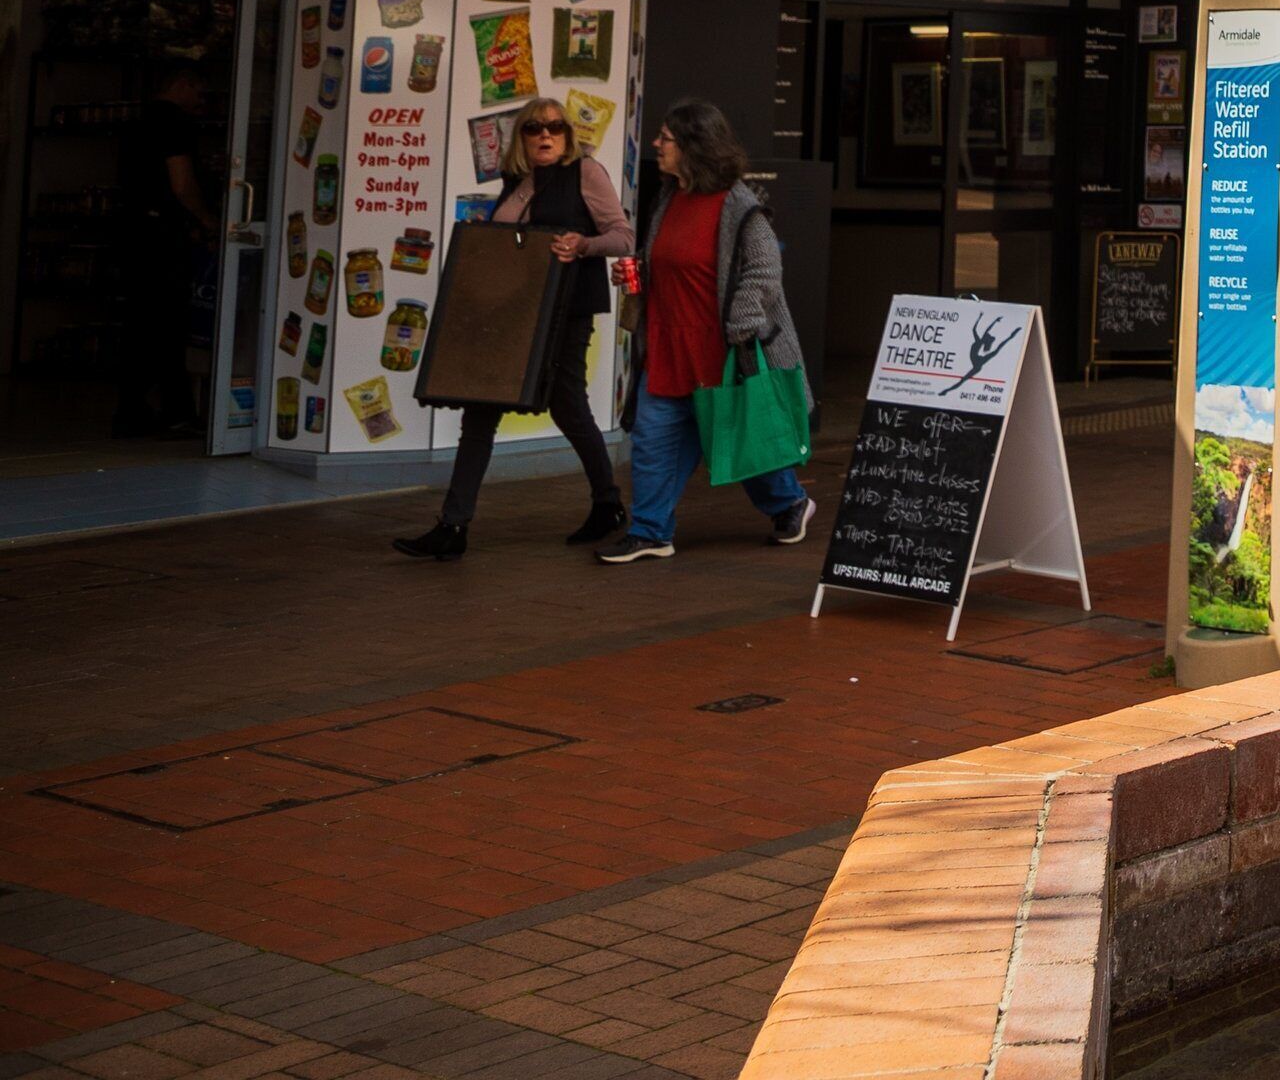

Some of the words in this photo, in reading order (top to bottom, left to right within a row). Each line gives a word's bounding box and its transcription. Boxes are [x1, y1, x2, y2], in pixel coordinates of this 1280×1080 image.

[1219, 28, 1261, 41] Armidale
[1215, 80, 1270, 98] Filtered
[368, 108, 425, 124] OPEN
[1215, 101, 1259, 118] Water
[1213, 121, 1250, 138] Refill
[364, 131, 426, 147] Mon-Sat
[1213, 141, 1268, 159] Station
[358, 152, 430, 171] 9am-6pm
[365, 177, 419, 197] Sunday
[1212, 180, 1248, 192] REDUCE
[355, 197, 428, 216] 9am-3pm
[1222, 196, 1244, 204] amount
[1211, 206, 1230, 214] bottles
[1232, 207, 1242, 215] you
[1244, 206, 1255, 215] buy
[1210, 228, 1238, 240] REUSE
[1108, 241, 1164, 261] LANEWAY
[1209, 254, 1225, 262] water
[1209, 276, 1247, 289] RECYCLE
[1209, 292, 1221, 300] your
[896, 307, 915, 318] NEW
[917, 308, 959, 322] ENGLAND
[889, 322, 945, 344] DANCE
[886, 345, 956, 370] THEATRE
[983, 384, 1004, 394] Phone
[877, 406, 911, 428] WE
[833, 563, 882, 583] UPSTAIRS:
[883, 573, 908, 588] MALL
[910, 577, 951, 594] ARCADE
